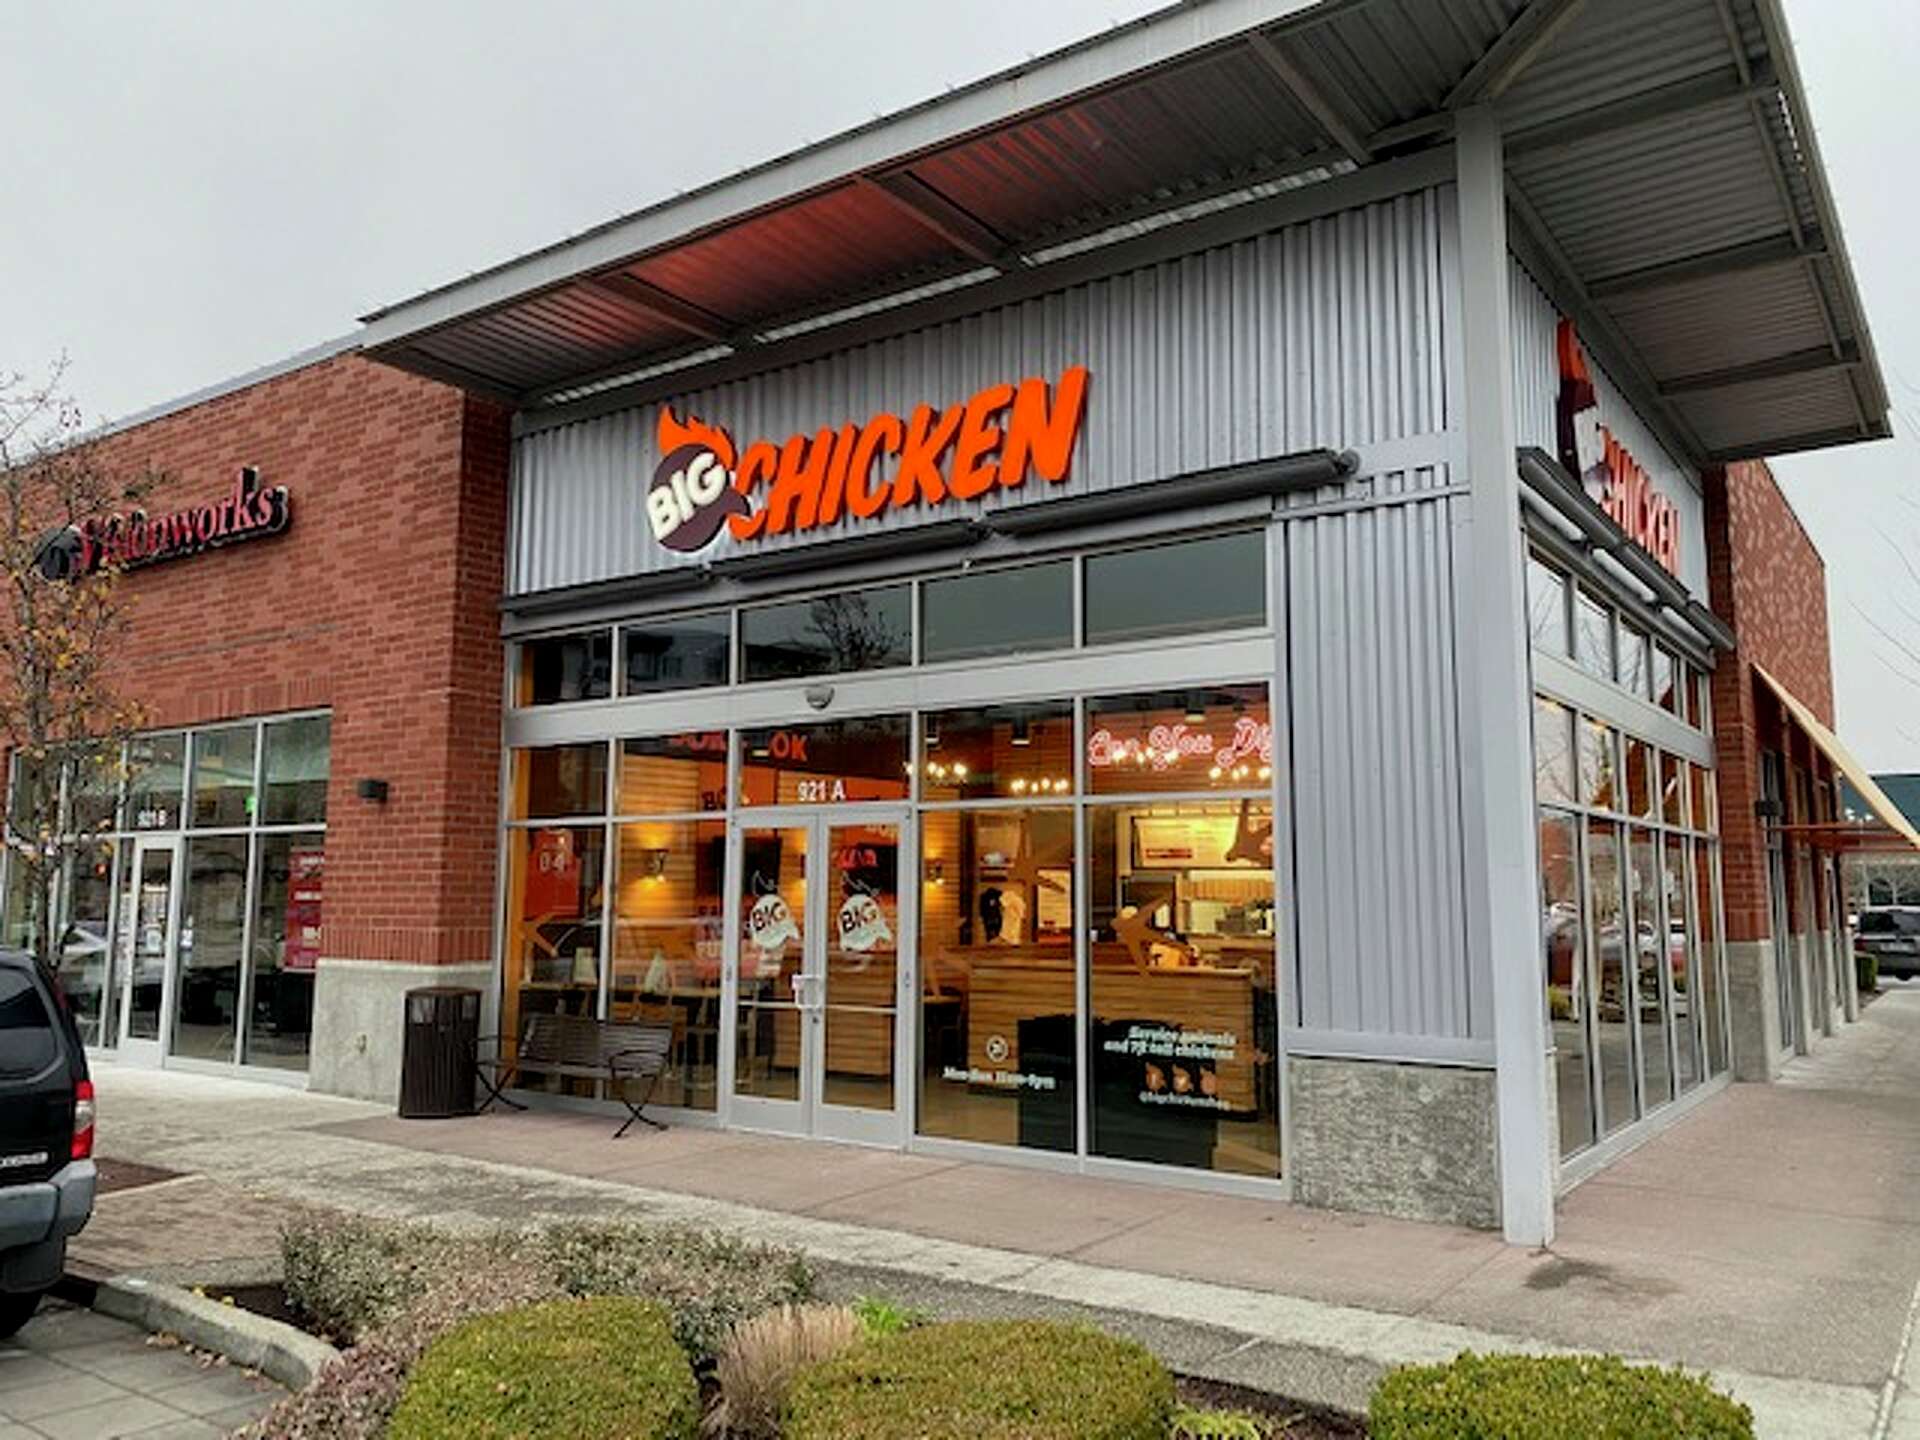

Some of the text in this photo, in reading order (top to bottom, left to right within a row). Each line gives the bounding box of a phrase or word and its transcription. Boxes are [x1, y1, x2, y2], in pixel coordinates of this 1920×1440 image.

[646, 365, 1088, 540] BIG CHICKEN
[798, 777, 846, 801] 921 A
[751, 902, 787, 931] BIG
[840, 901, 877, 934] BIG
